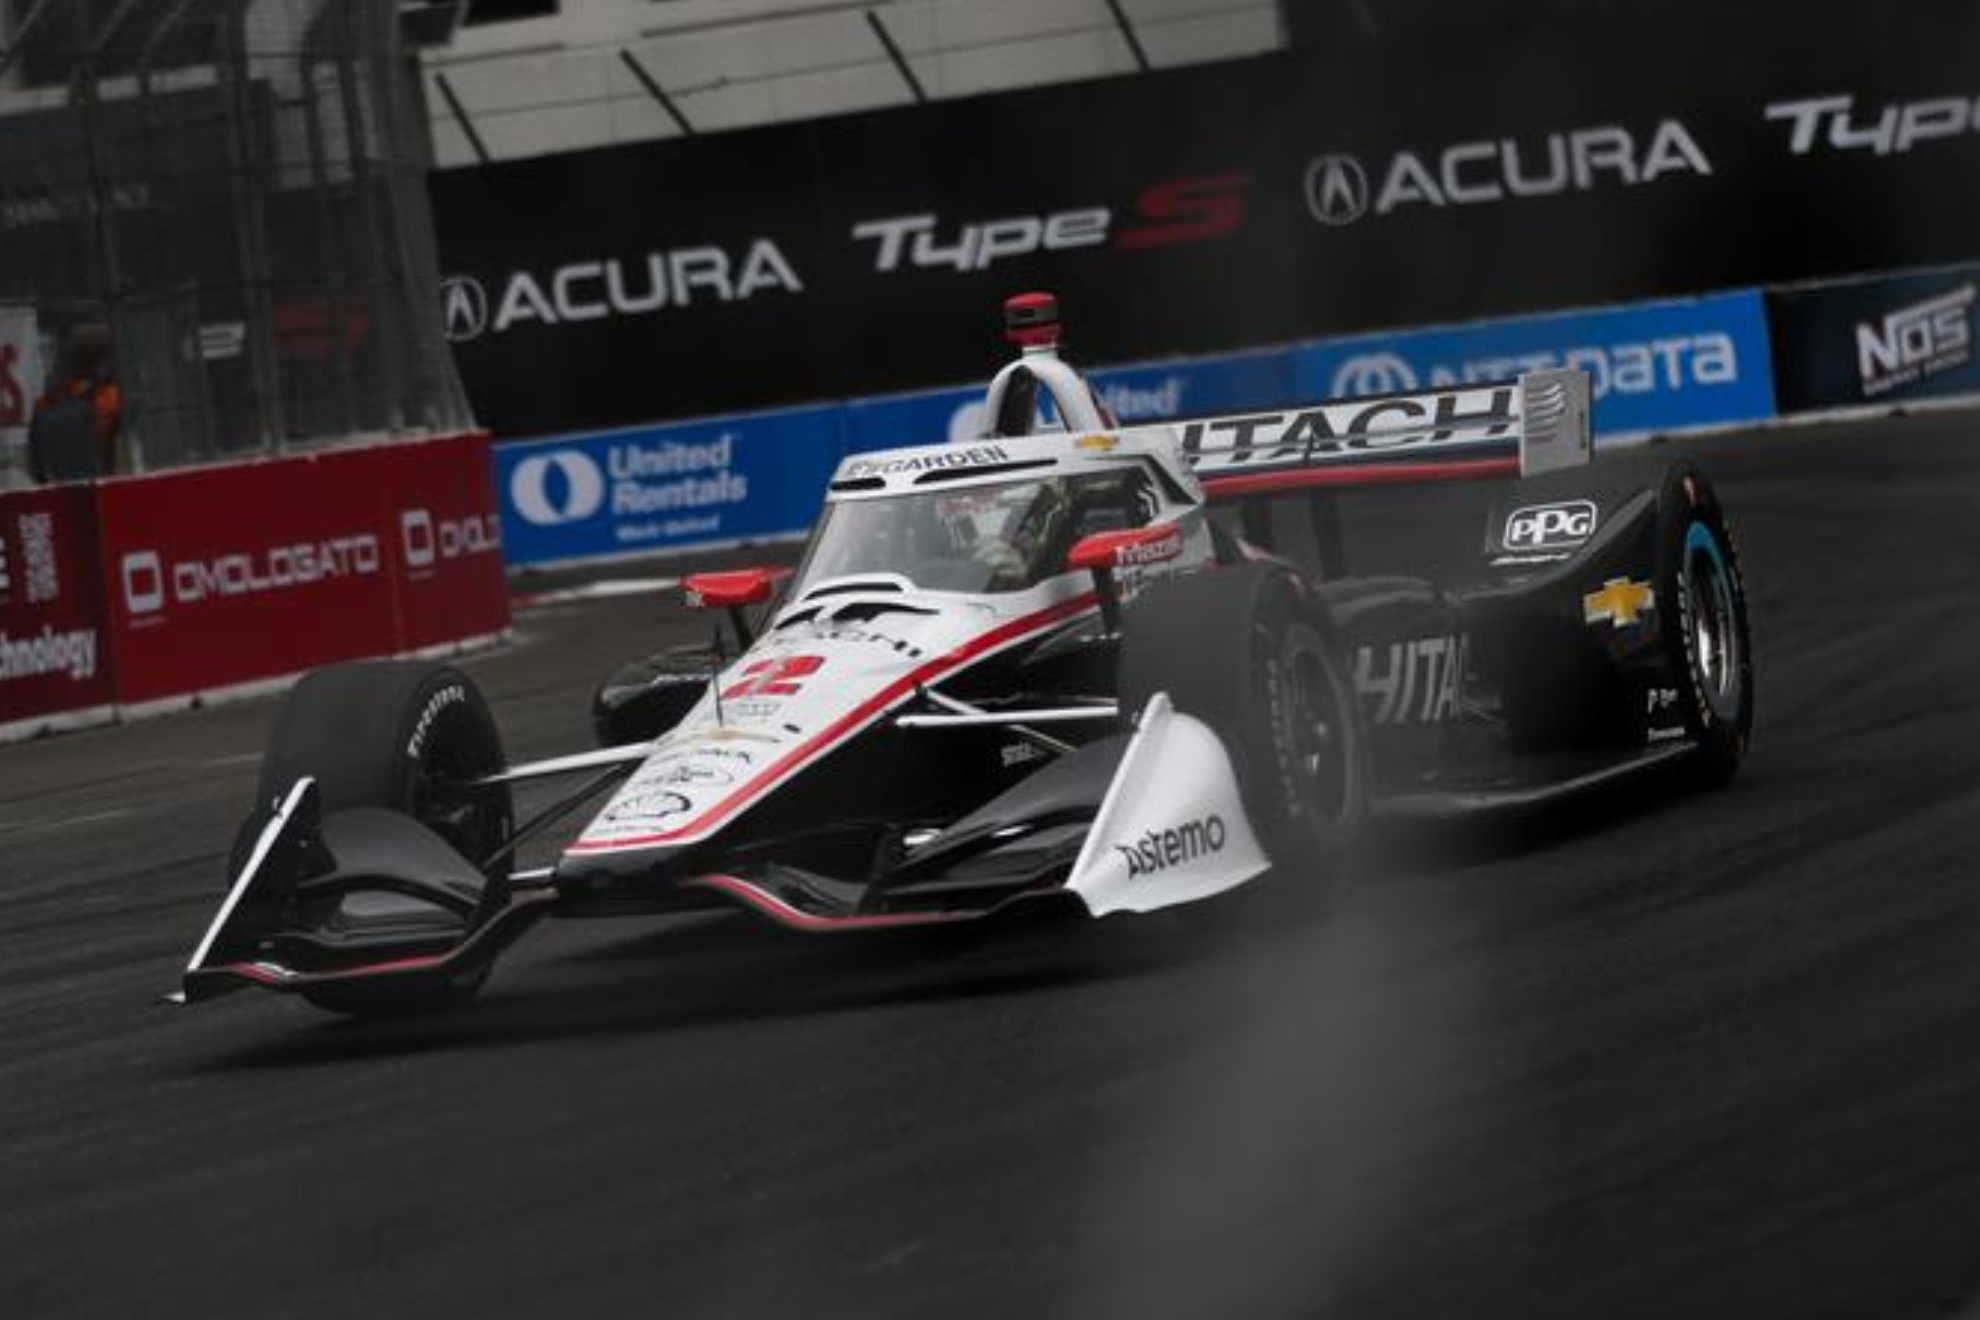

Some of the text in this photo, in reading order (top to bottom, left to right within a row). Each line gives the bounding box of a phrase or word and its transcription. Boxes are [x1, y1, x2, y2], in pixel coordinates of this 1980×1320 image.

[1764, 92, 1980, 156] Typ
[1375, 117, 1713, 216] ACURA
[852, 171, 1252, 273] Type S
[493, 237, 803, 332] ACURA
[1855, 282, 1976, 380] NOS
[606, 432, 731, 480] United
[1181, 389, 1513, 464] ITACH
[611, 469, 748, 516] Rentals
[1510, 509, 1591, 545] PPG
[172, 533, 381, 602] OMOLOGATO
[0, 624, 97, 681] hnology
[720, 655, 827, 699] 2
[1114, 814, 1225, 880] Astemo
